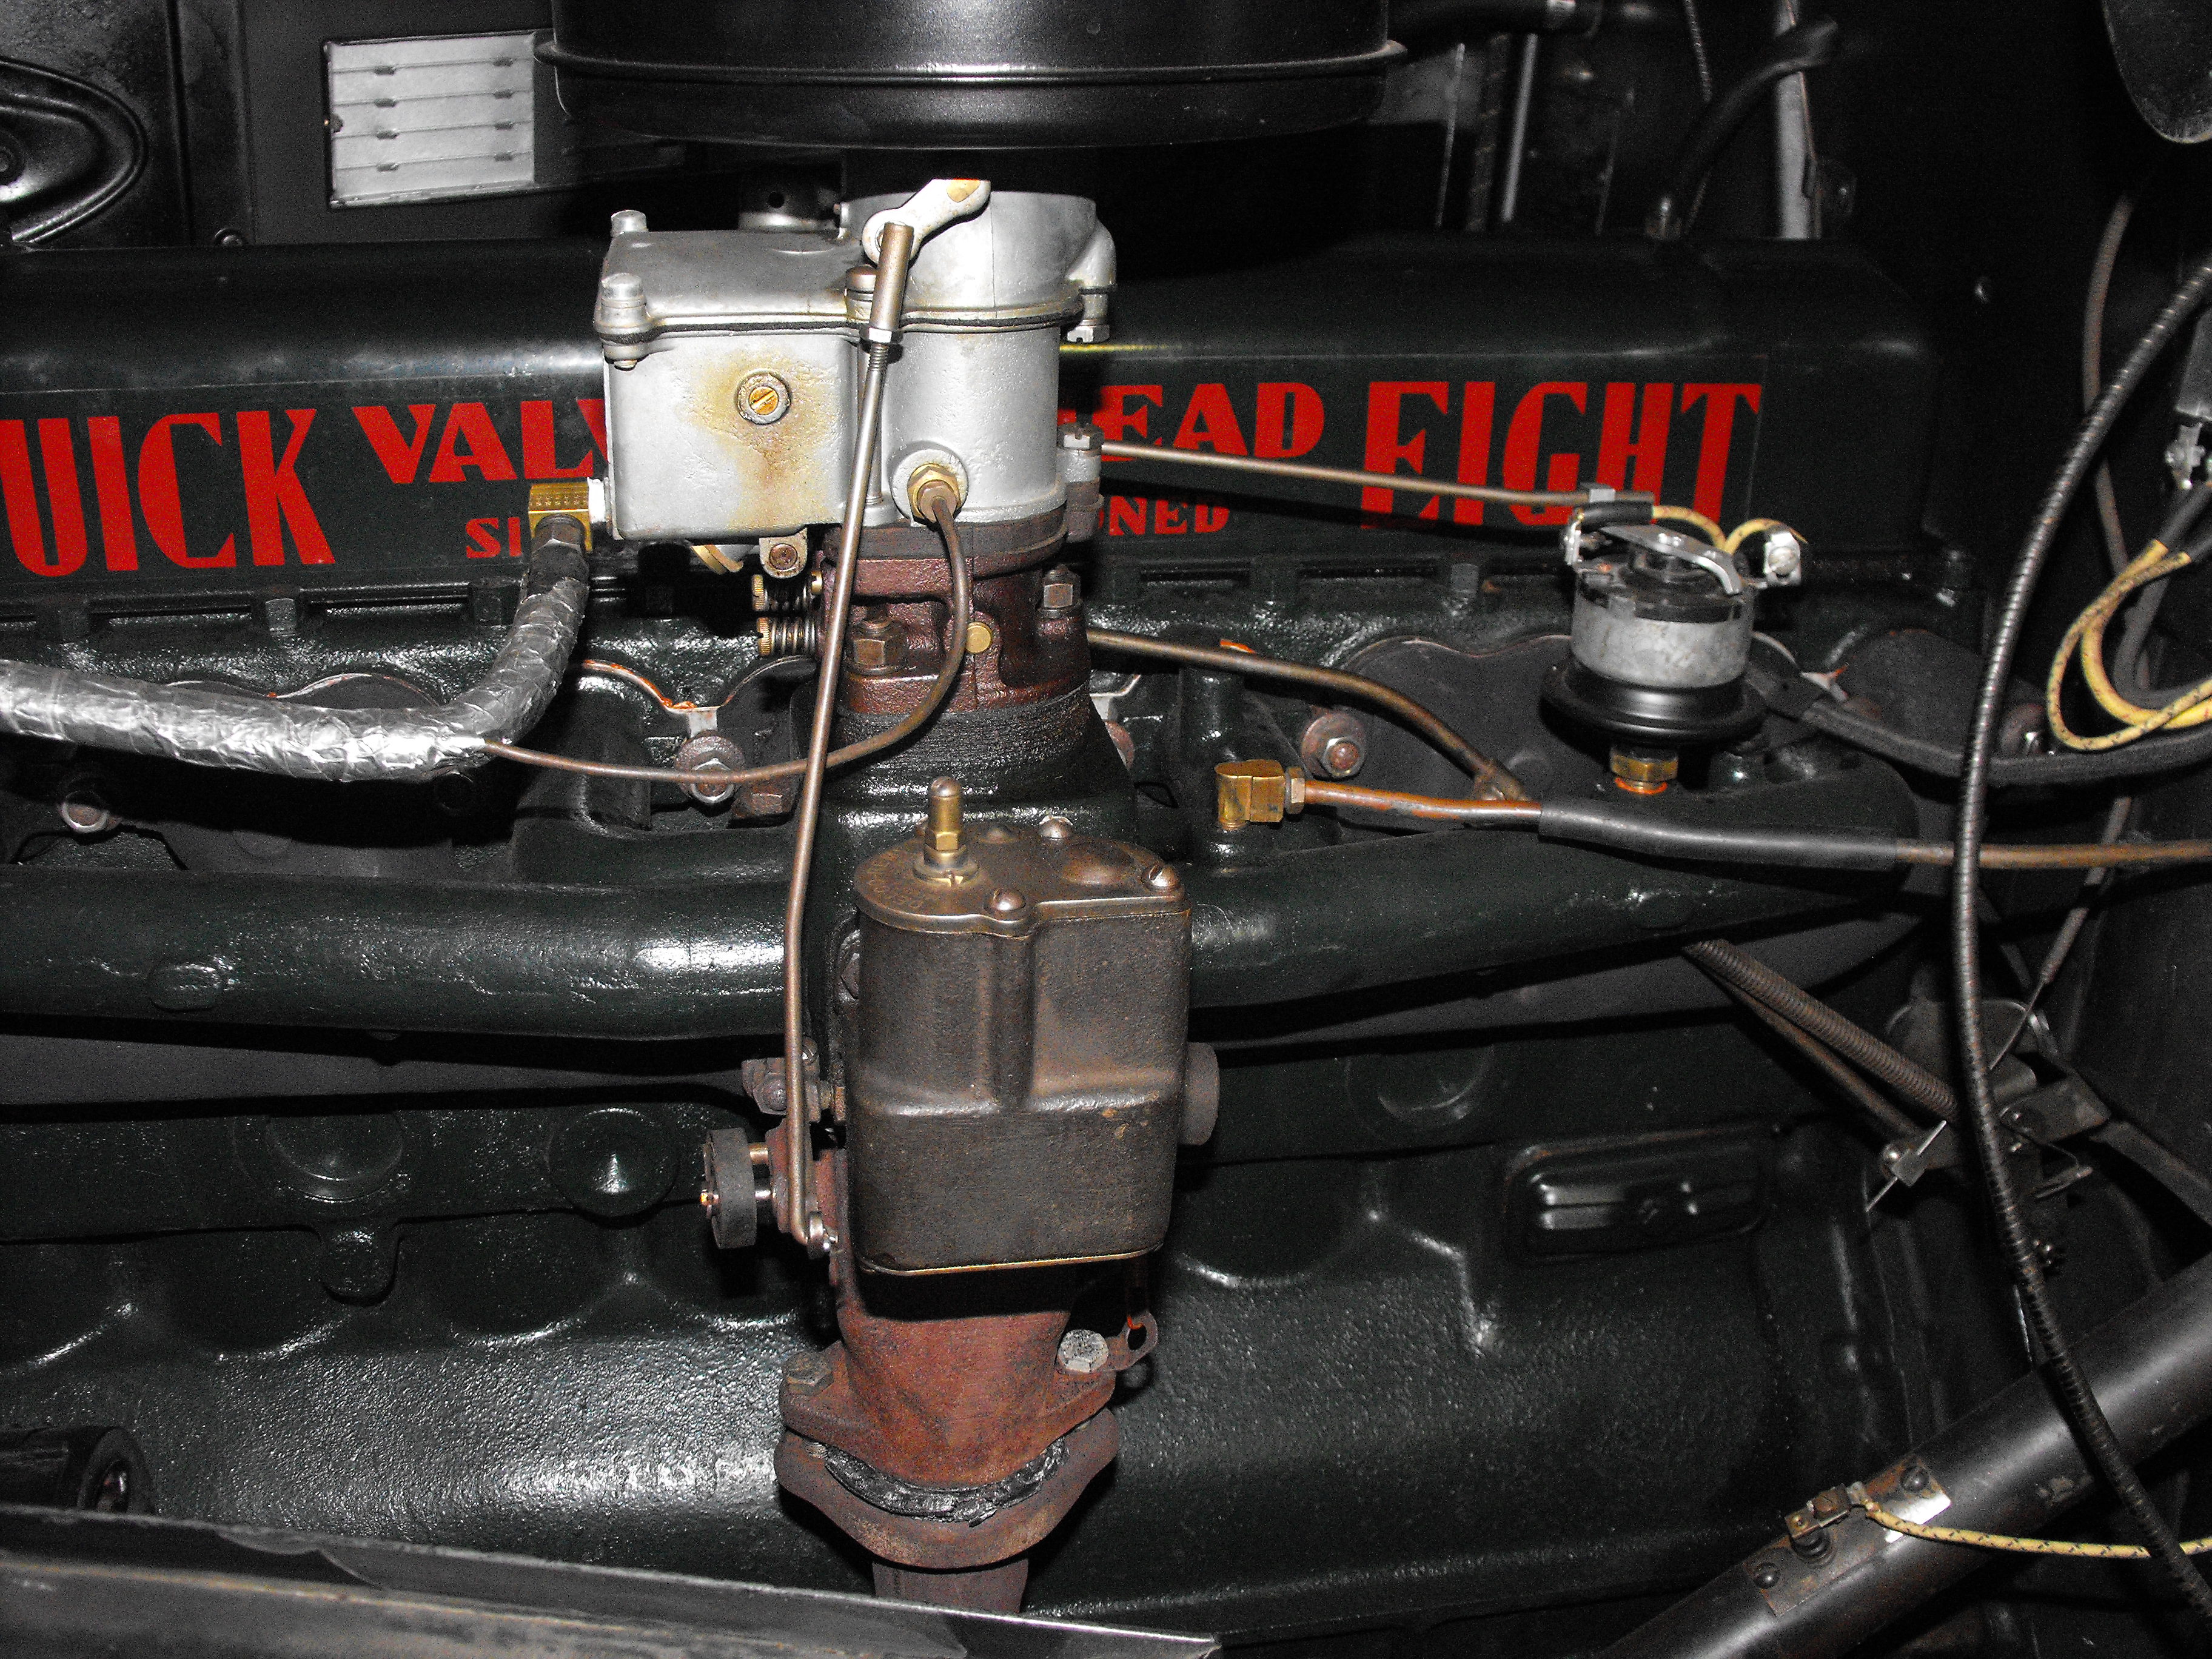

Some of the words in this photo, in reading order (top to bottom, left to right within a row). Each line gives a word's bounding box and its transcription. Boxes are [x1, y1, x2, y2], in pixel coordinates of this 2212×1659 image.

[0, 408, 336, 577] UICK
[1057, 382, 1326, 462] EAD
[1361, 380, 1763, 529] EIGHT
[1098, 494, 1230, 537] NED
